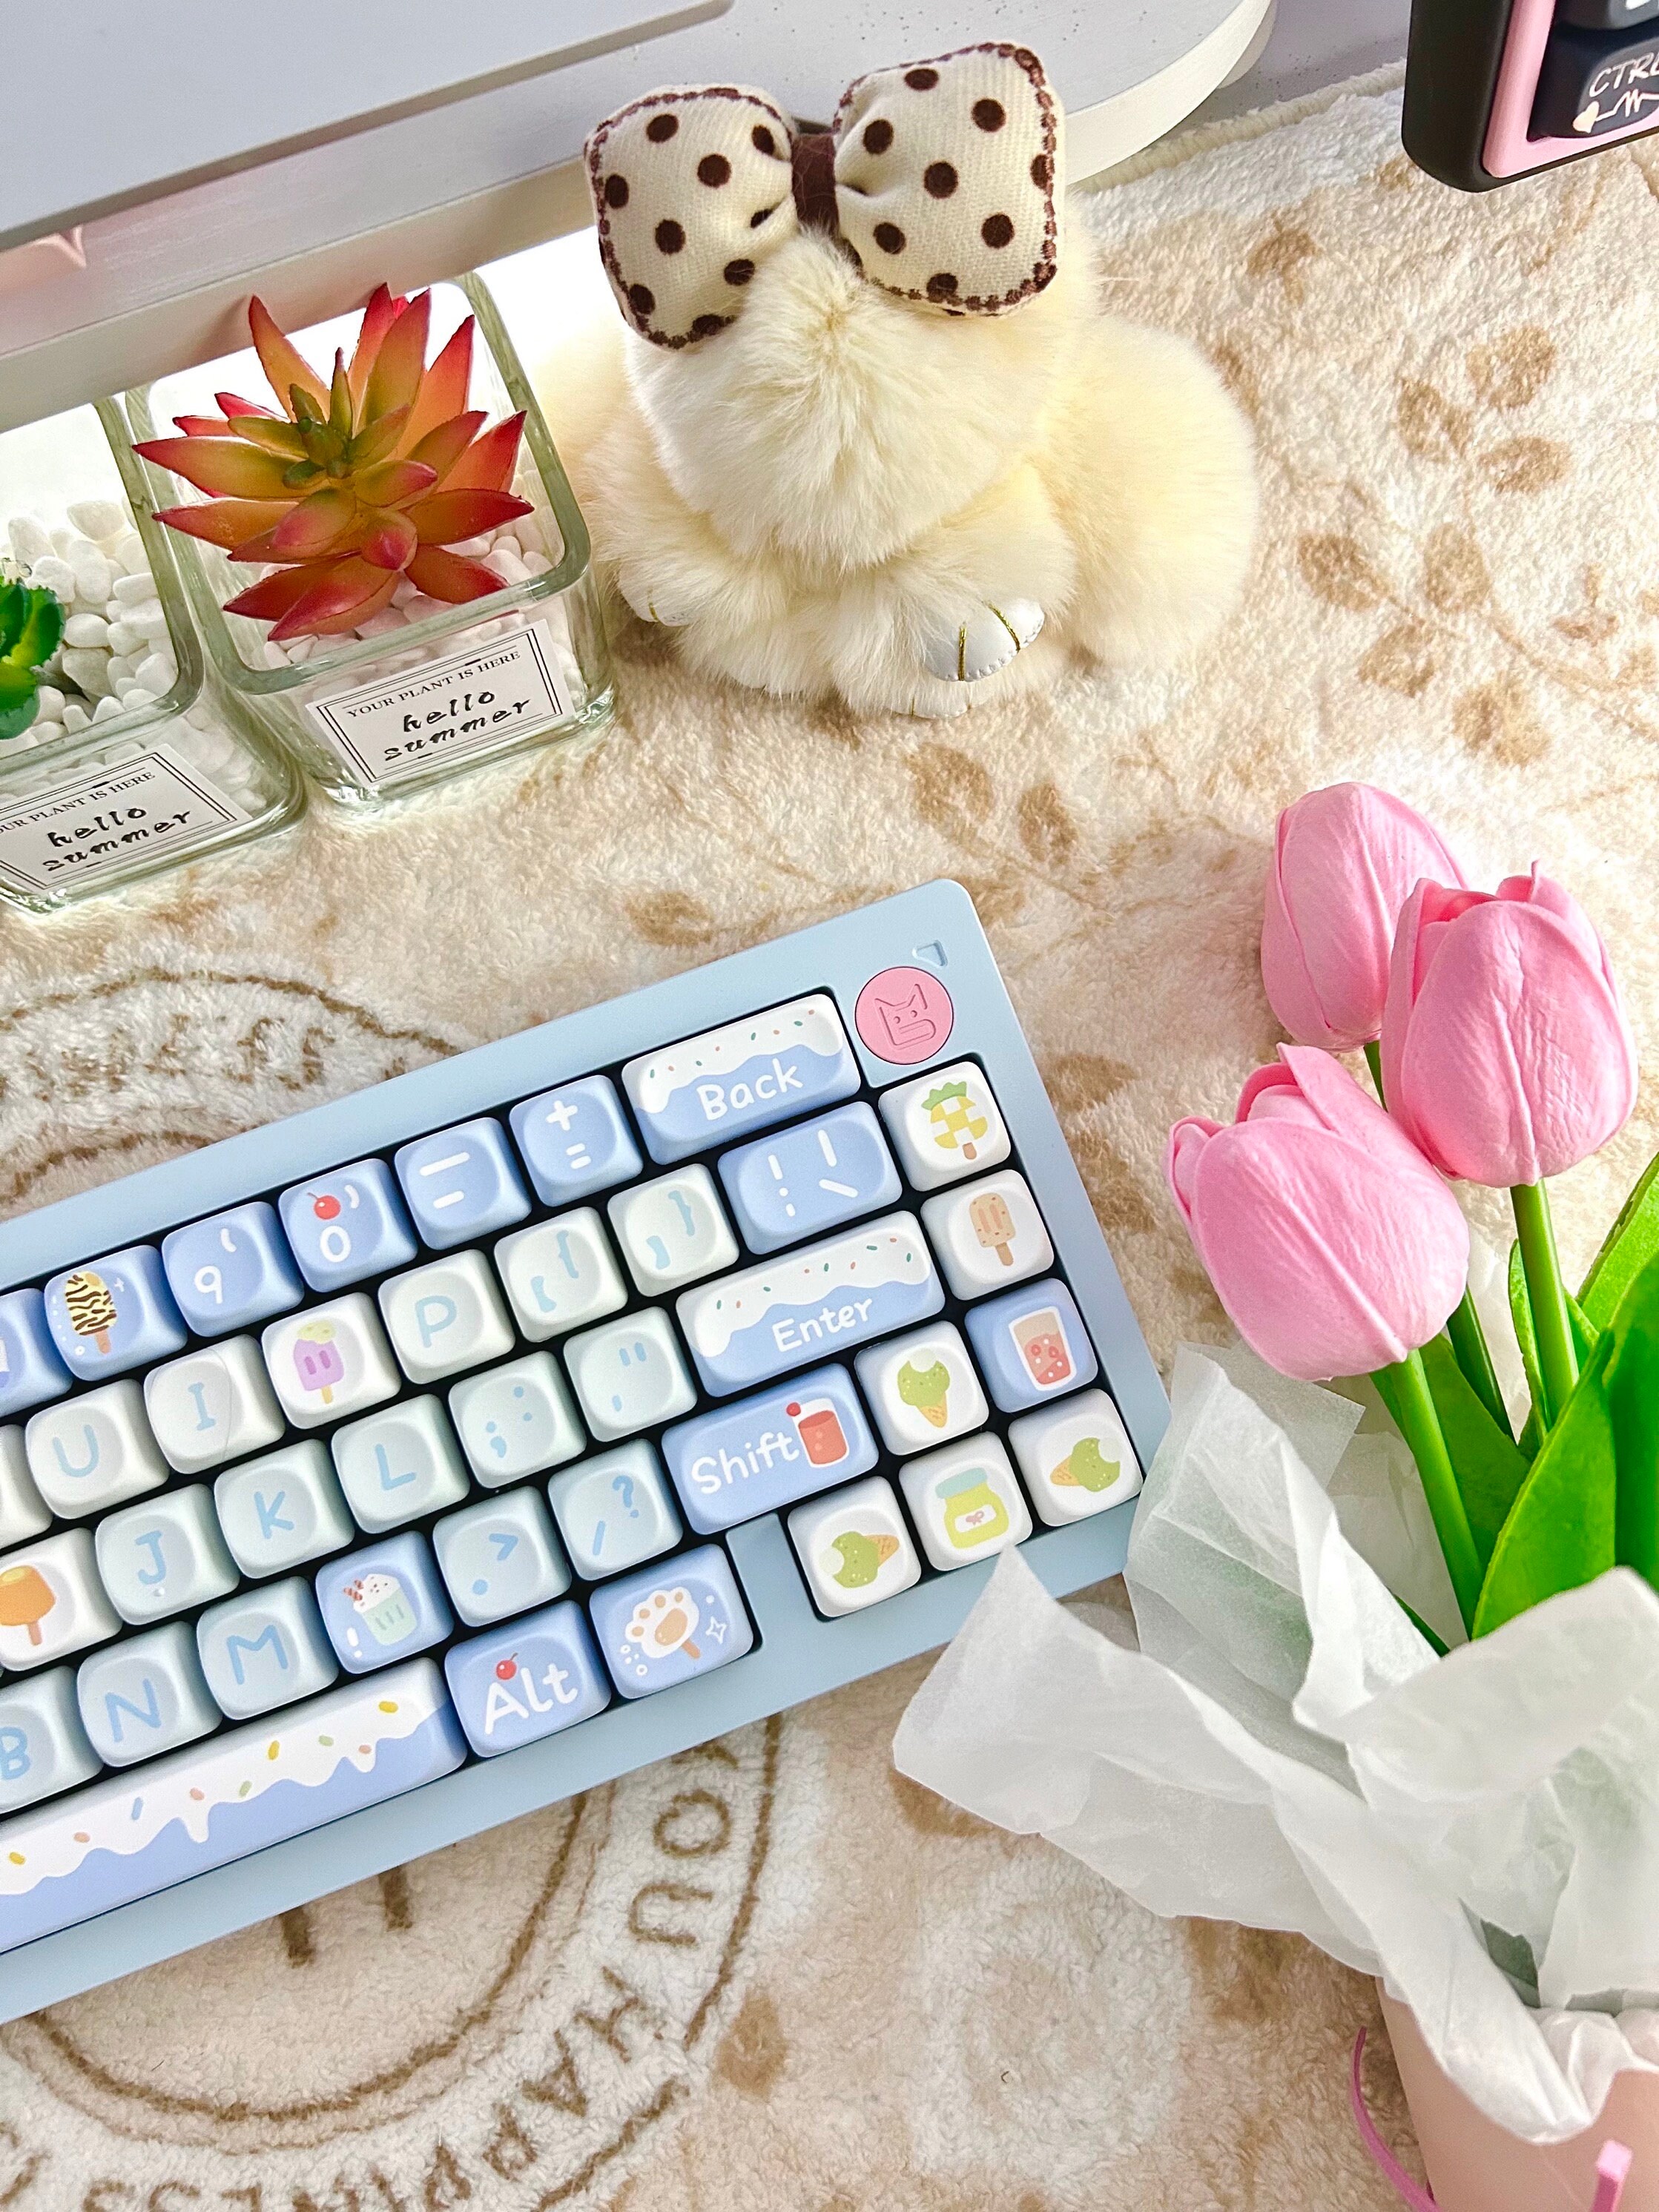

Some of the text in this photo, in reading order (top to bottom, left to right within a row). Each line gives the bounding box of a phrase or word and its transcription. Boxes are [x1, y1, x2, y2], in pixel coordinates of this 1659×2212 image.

[347, 651, 521, 717] YOUR PLANT IS HERE
[384, 699, 530, 761] summer
[403, 691, 495, 733] hello
[29, 798, 86, 822] PLANT
[89, 790, 108, 801] IS
[108, 771, 156, 794] HERE
[42, 810, 191, 871] summer
[47, 808, 147, 847] hello
[696, 1058, 804, 1120] Back
[194, 1265, 224, 1304] 9
[414, 1294, 458, 1348] P
[771, 1298, 874, 1352] Enter
[188, 1381, 217, 1432] I
[52, 1424, 100, 1478] U
[375, 1444, 417, 1491] L
[690, 1430, 800, 1495] Shift
[253, 1490, 294, 1539] K
[135, 1530, 168, 1585] J
[226, 1623, 289, 1686] M
[104, 1678, 163, 1743] N
[482, 1663, 578, 1735] Alt
[0, 1727, 31, 1780] B
